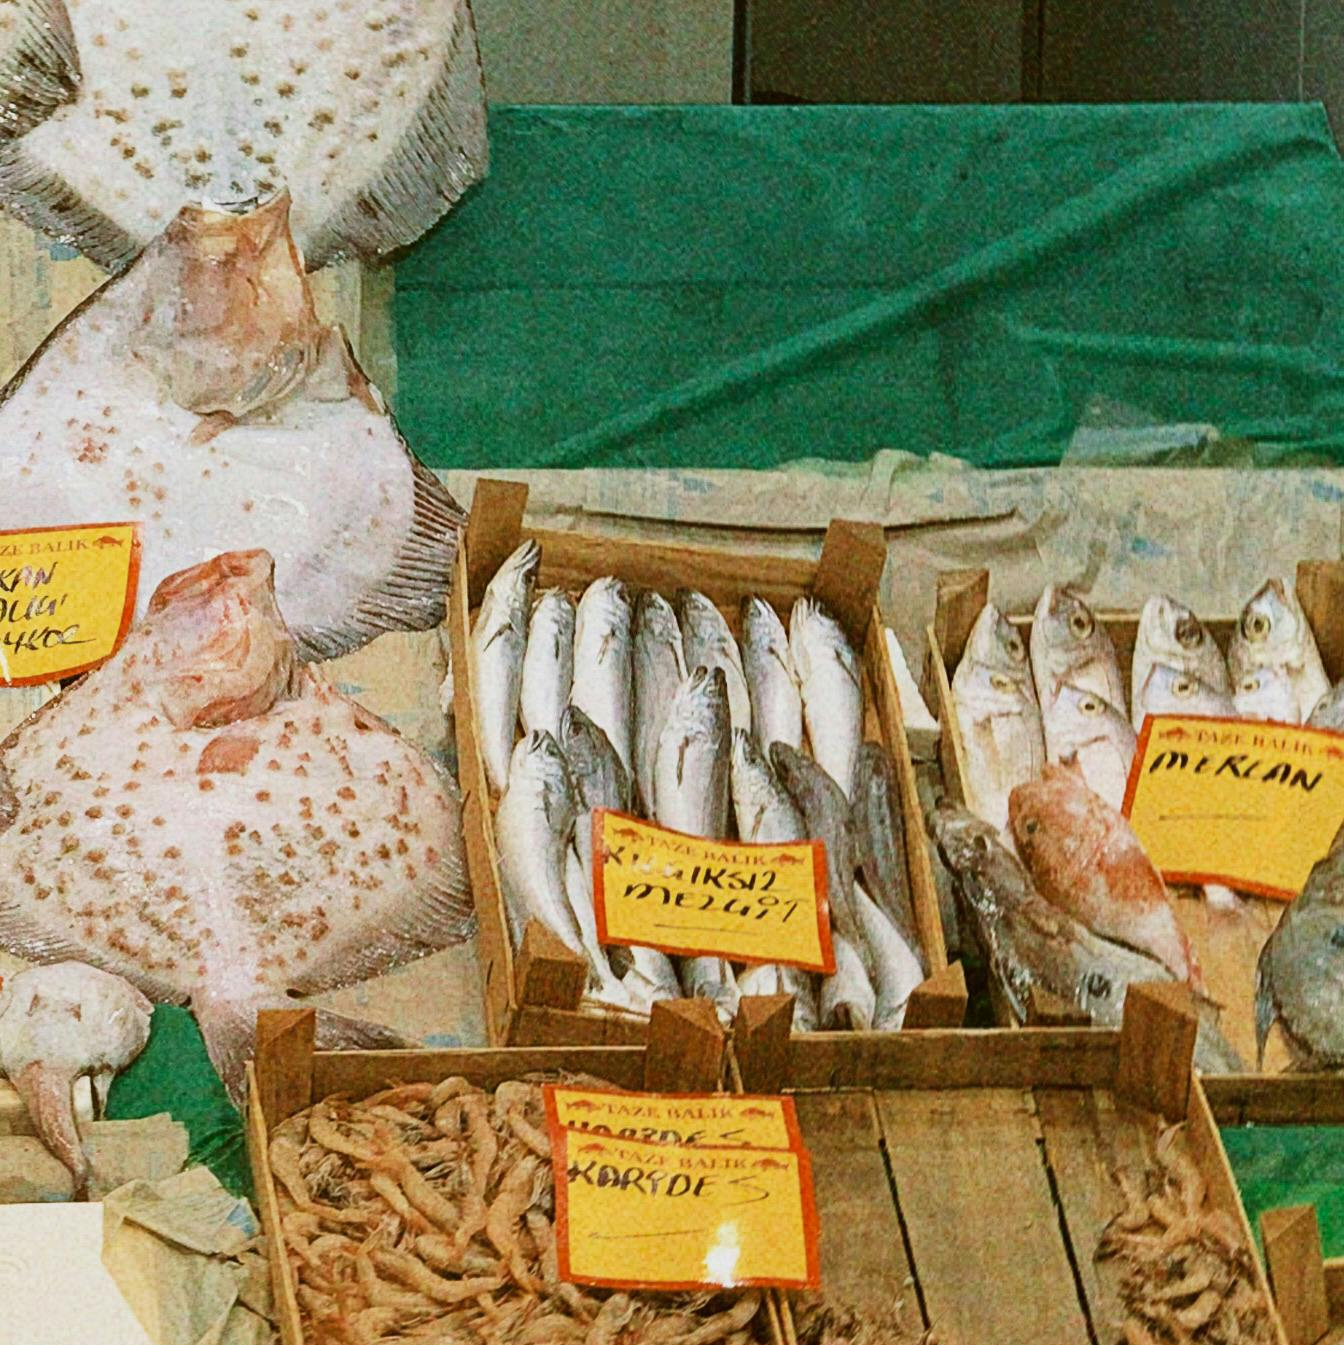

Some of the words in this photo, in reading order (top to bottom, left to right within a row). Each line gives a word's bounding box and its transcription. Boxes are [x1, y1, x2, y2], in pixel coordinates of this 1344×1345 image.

[29, 539, 90, 554] BALIK
[1197, 729, 1242, 746] TAZE
[1253, 736, 1312, 755] BALIK
[647, 836, 698, 855] TAZE
[704, 850, 765, 866] BALIK
[605, 1103, 660, 1119] TAZE
[667, 1103, 734, 1119] BALIK
[611, 1147, 667, 1167] TAZE
[678, 1156, 748, 1170] BALIK
